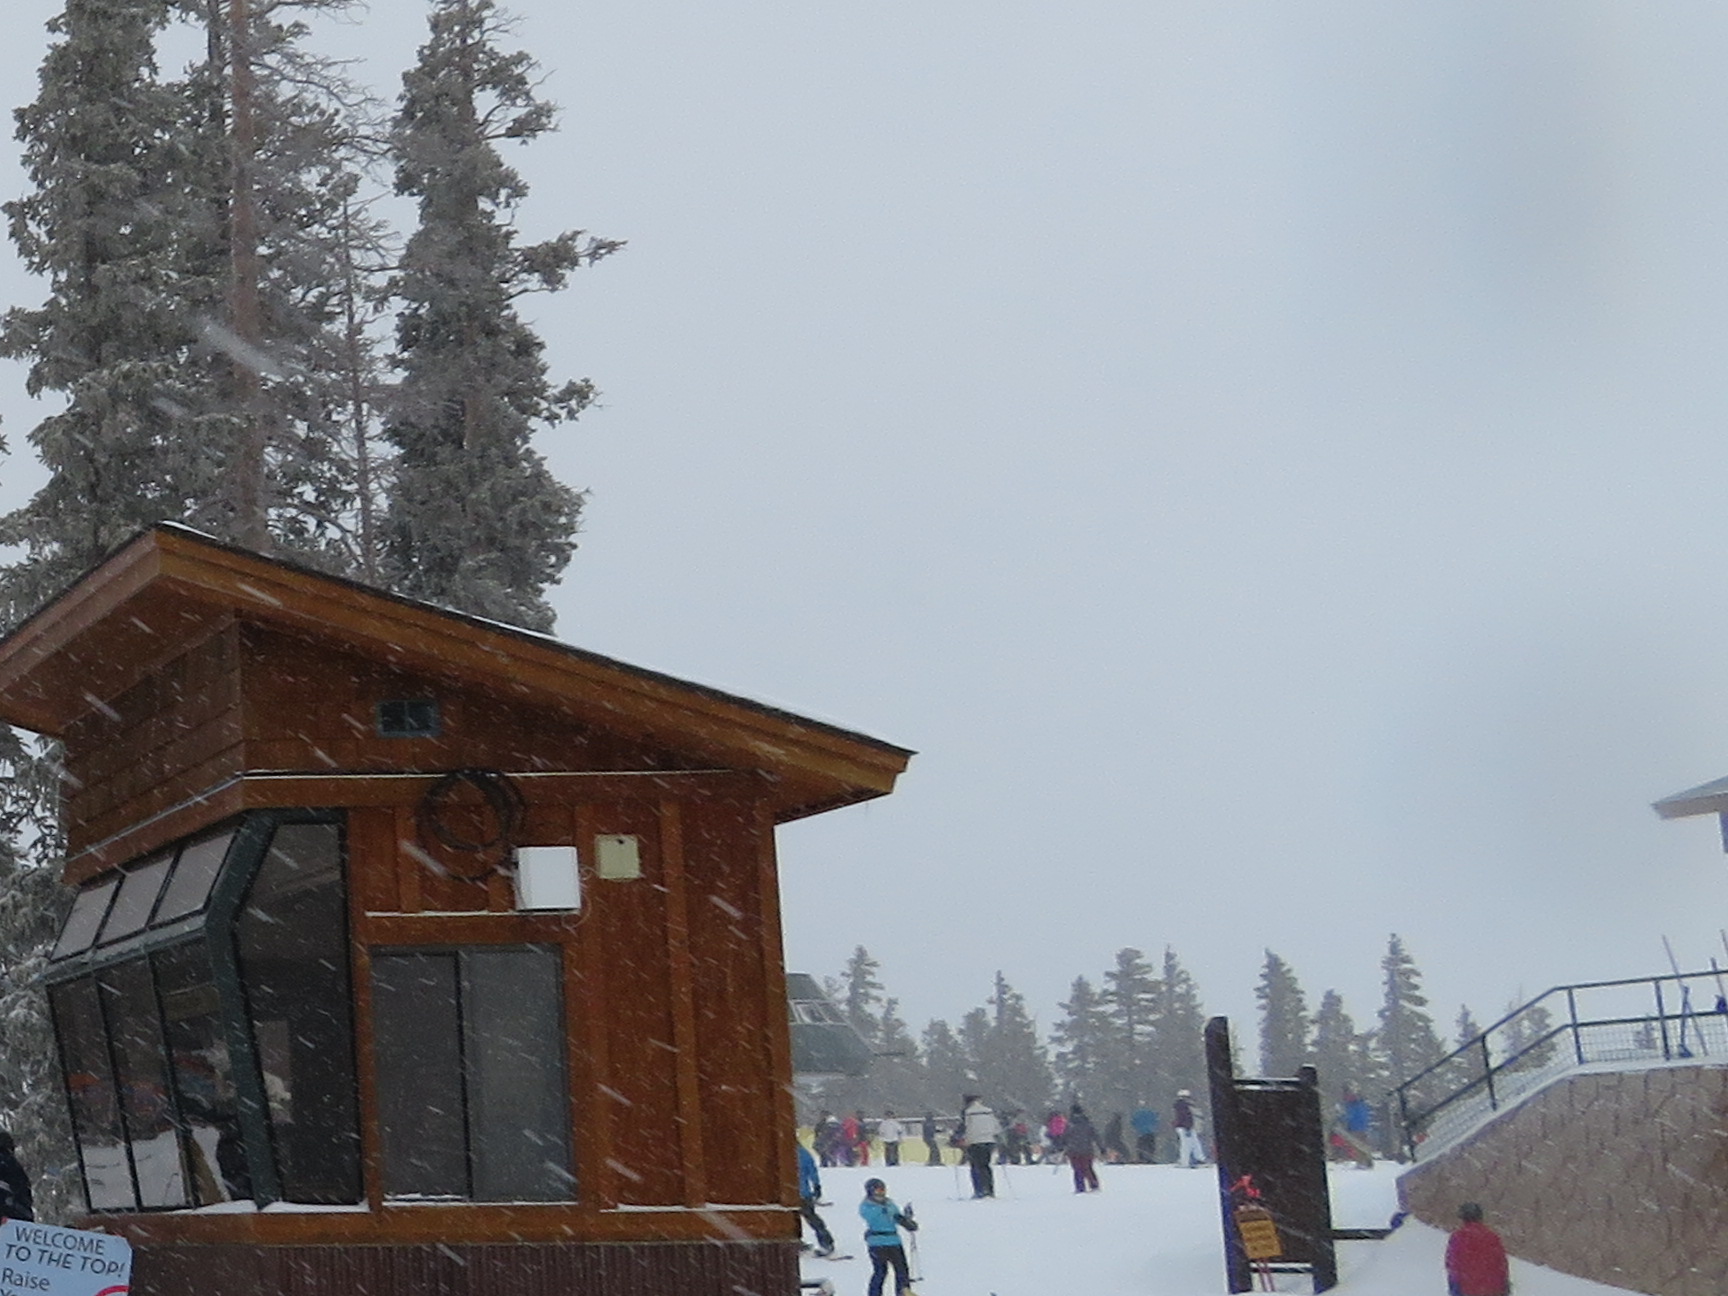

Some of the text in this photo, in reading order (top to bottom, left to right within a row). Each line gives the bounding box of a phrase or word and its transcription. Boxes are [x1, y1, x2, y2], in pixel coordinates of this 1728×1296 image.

[15, 1226, 105, 1255] WELCOME
[5, 1243, 125, 1278] TO THE TOP!
[1, 1267, 50, 1291] Raise
